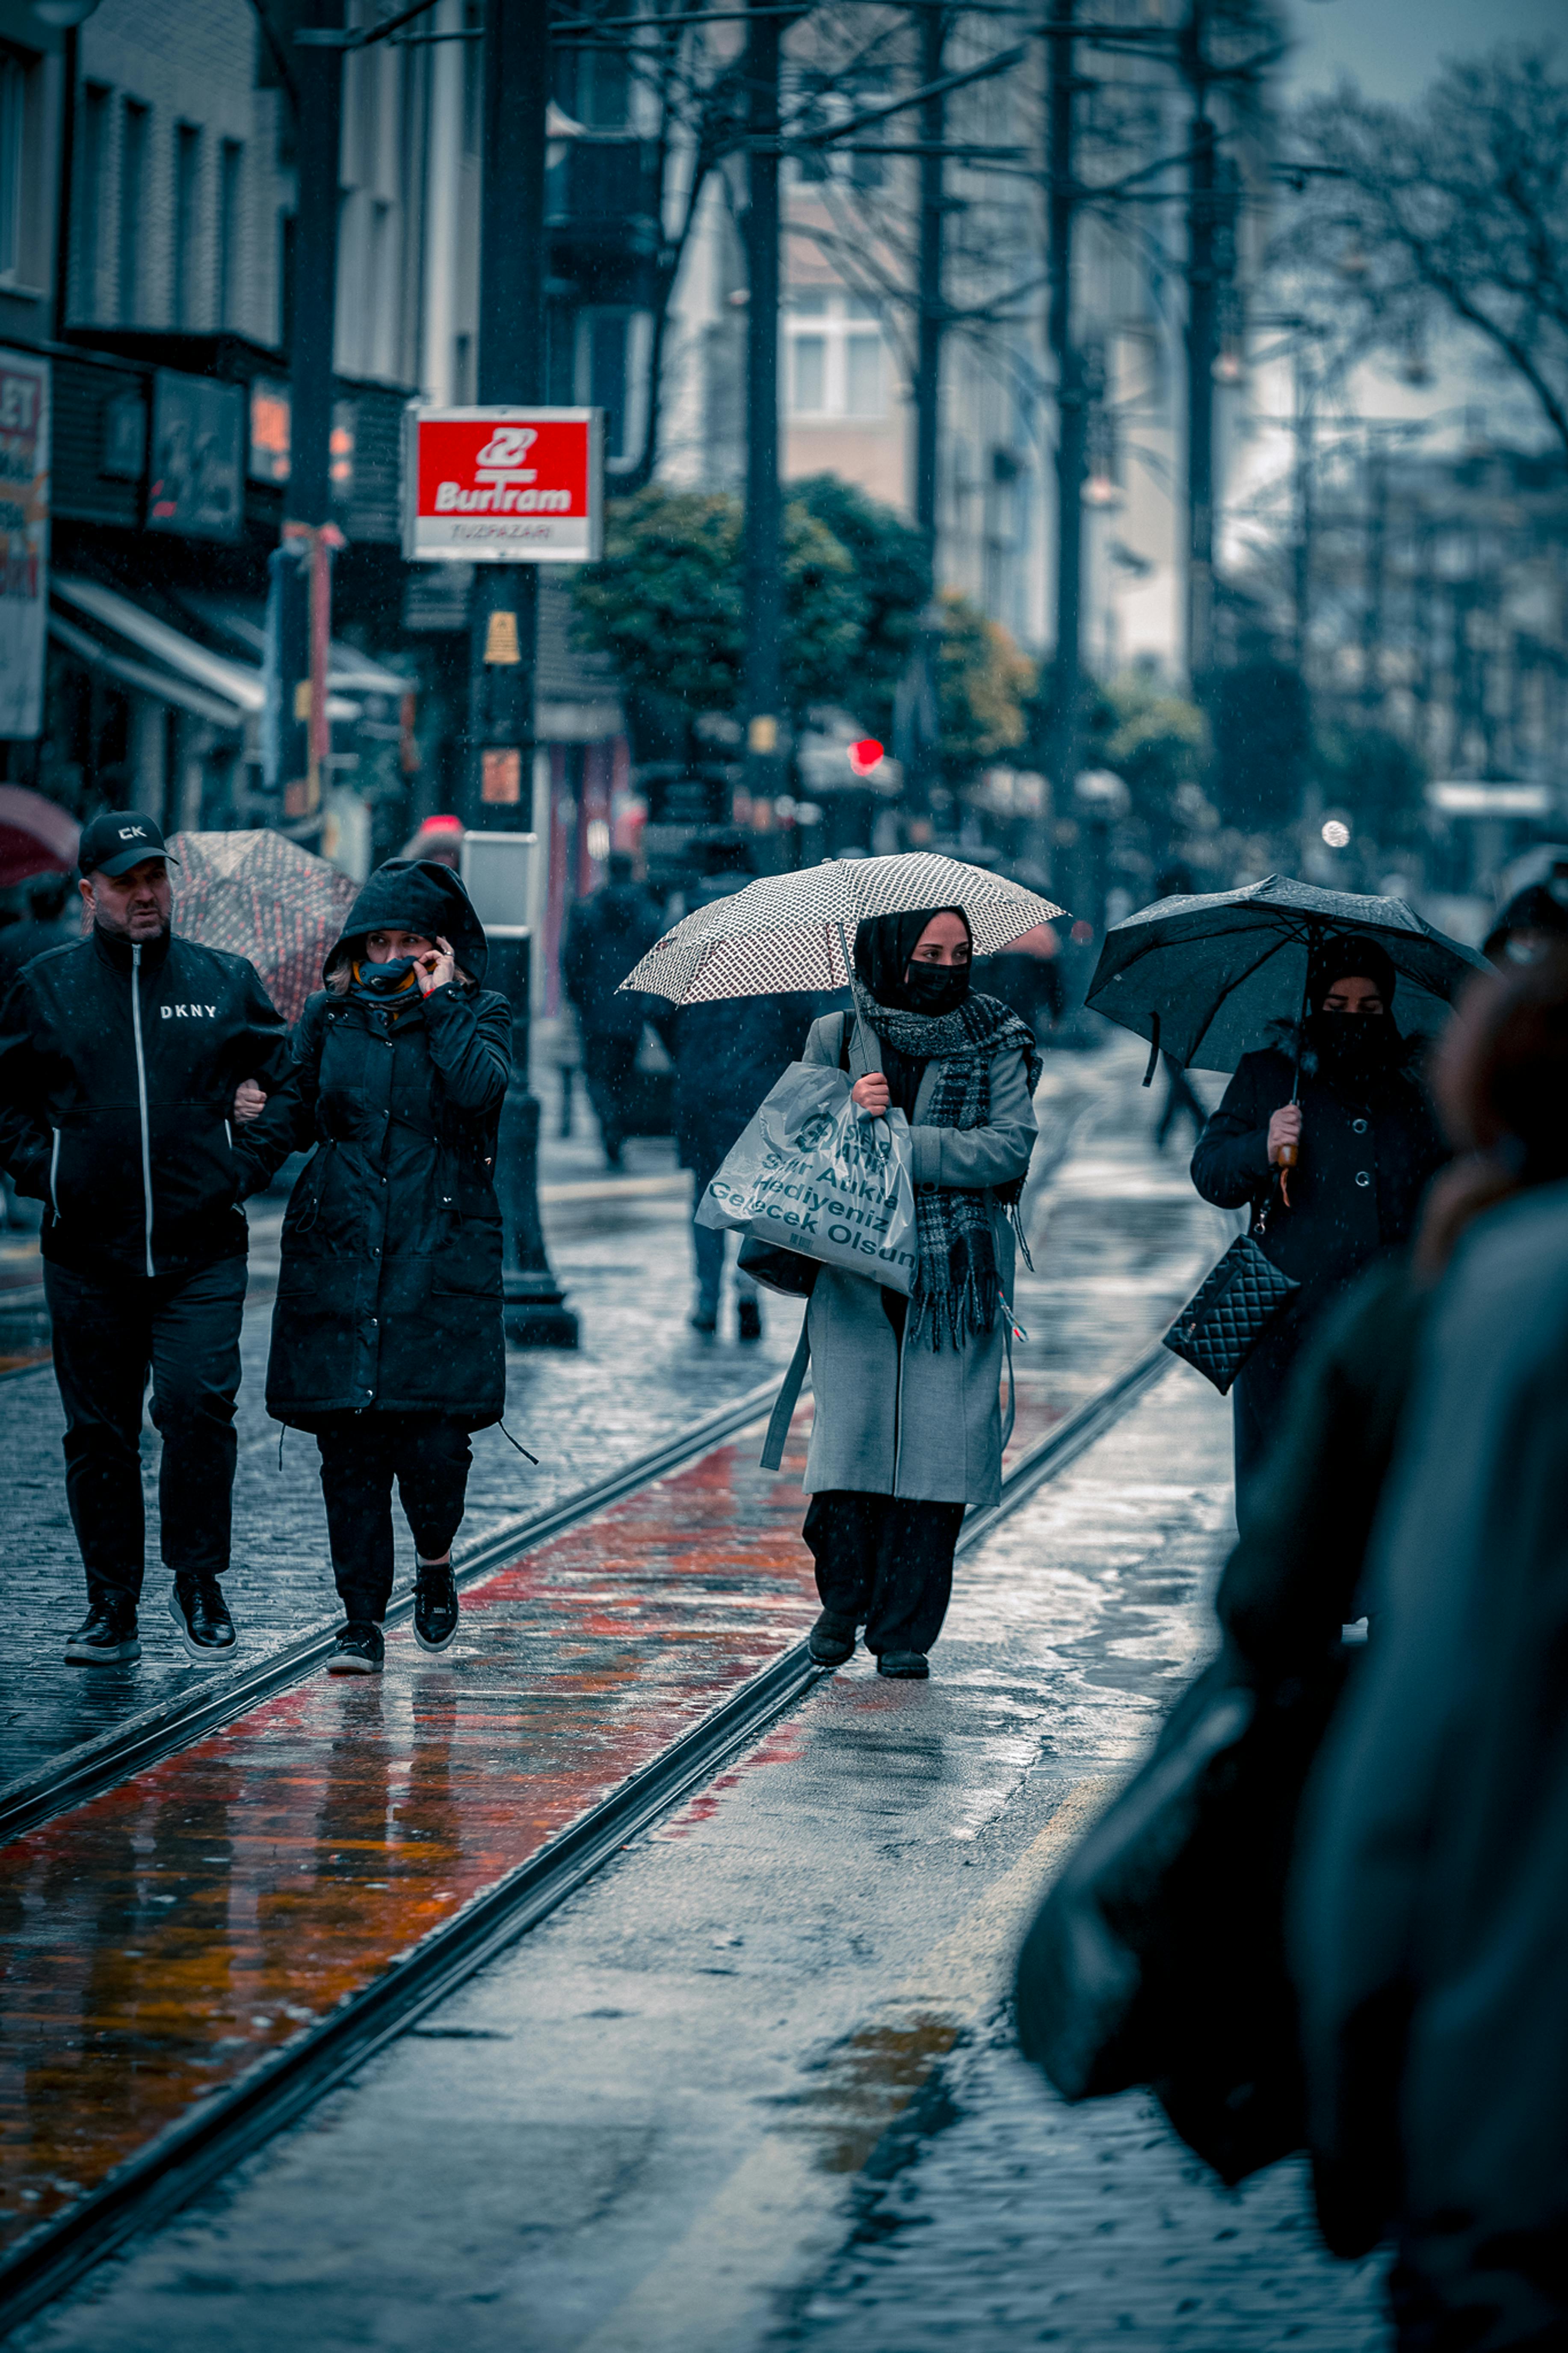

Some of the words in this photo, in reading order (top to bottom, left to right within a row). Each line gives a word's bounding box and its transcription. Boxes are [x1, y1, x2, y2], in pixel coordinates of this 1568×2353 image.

[118, 826, 148, 840] CK
[160, 1004, 216, 1019] DKNY
[752, 1174, 890, 1233] Hediyeniz
[709, 1182, 819, 1234] Gelecek
[828, 1224, 915, 1268] Olsun
